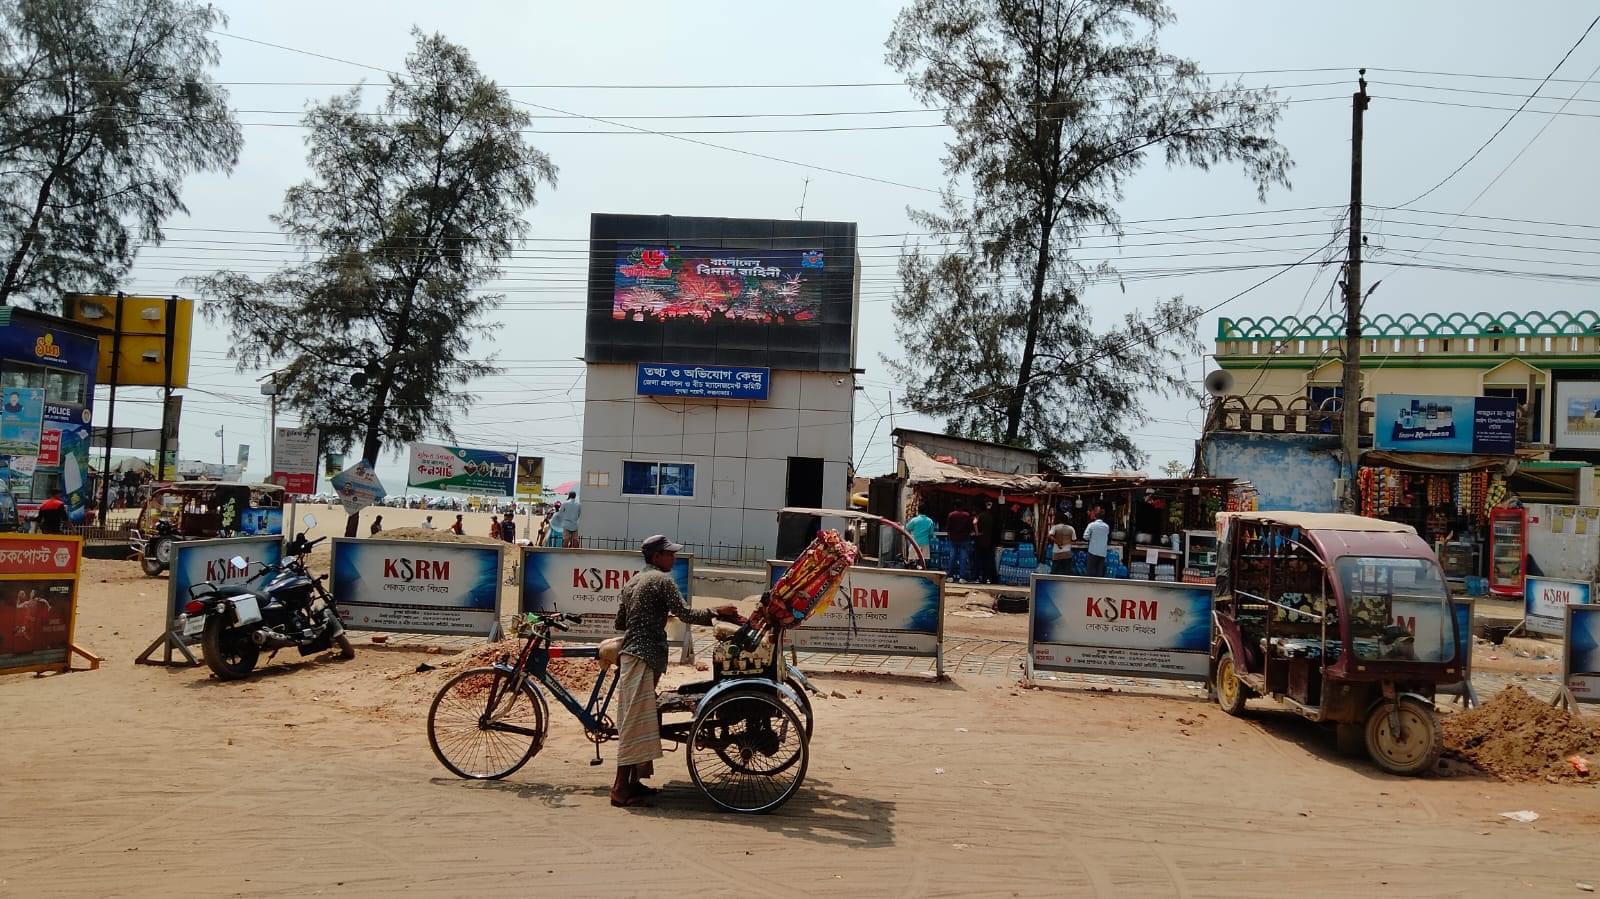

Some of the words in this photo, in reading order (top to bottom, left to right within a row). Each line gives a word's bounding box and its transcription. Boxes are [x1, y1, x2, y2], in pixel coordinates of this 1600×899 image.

[697, 265, 735, 276] বিমান
[739, 266, 781, 278] বাহিনী
[35, 337, 60, 358] Sun
[644, 367, 667, 378] তথ্য
[671, 369, 681, 378] ও
[684, 367, 732, 380] অভিযোগ
[736, 371, 763, 382] কেন্দ্র
[743, 382, 761, 390] কমিটি
[47, 406, 71, 416] POLICE
[384, 558, 450, 582] KSRM
[829, 585, 889, 611] SRM
[1543, 588, 1570, 603] KSRM
[1086, 597, 1158, 622] KSRM
